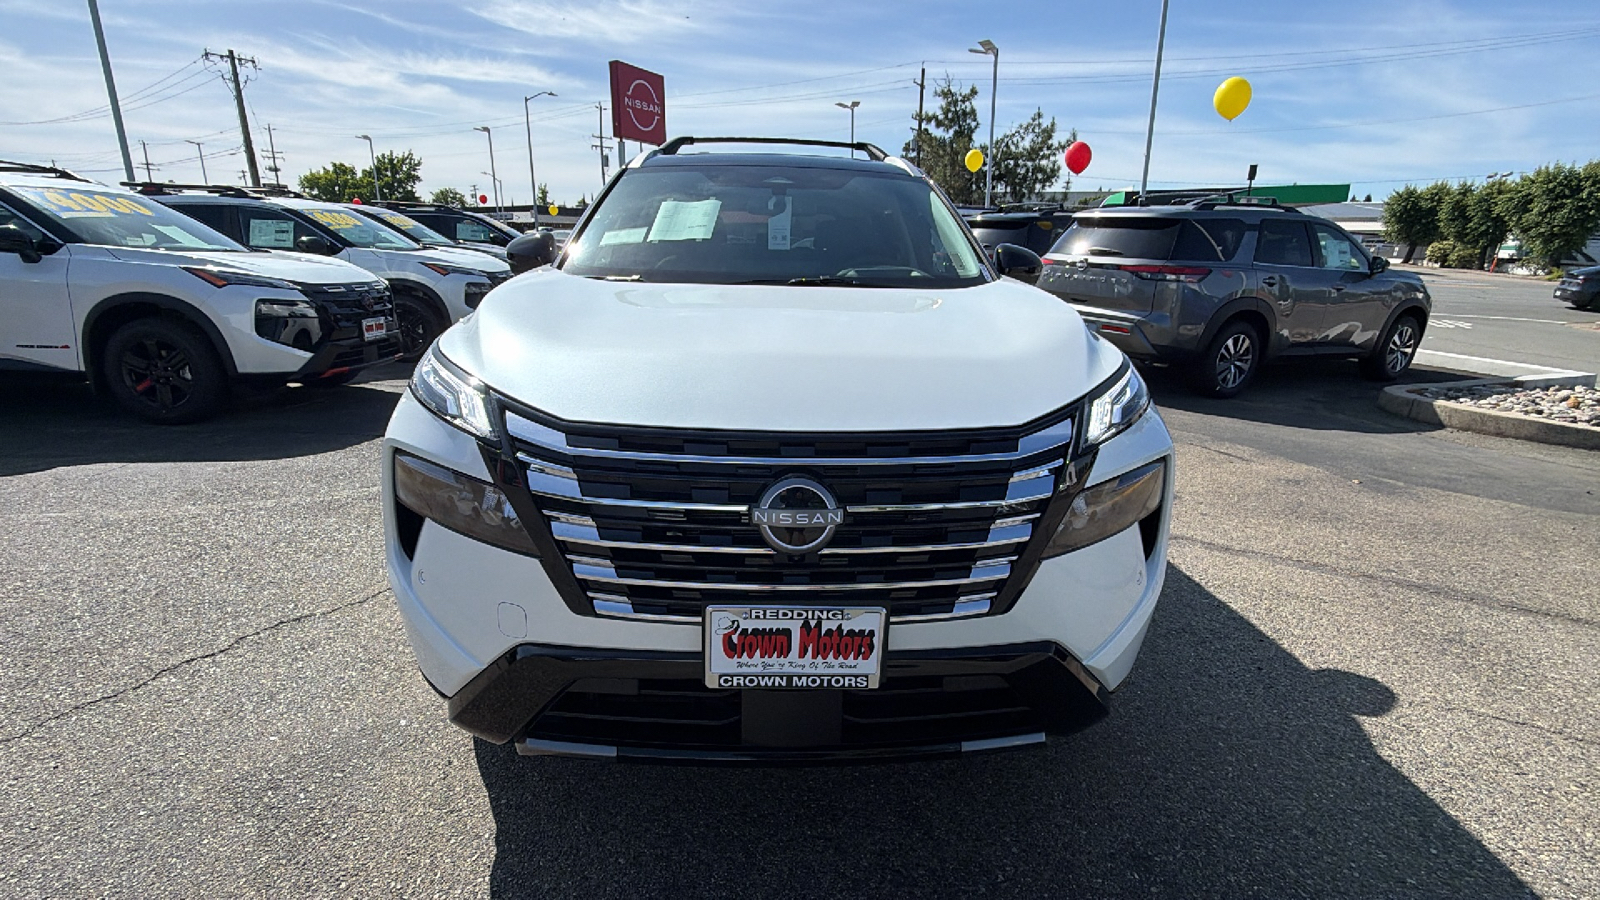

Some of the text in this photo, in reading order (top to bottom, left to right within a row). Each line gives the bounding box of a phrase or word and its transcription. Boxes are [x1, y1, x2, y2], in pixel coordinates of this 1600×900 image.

[624, 96, 661, 114] NISSAN
[754, 511, 841, 524] NISSAN
[751, 609, 843, 620] REDDING
[722, 621, 875, 661] Crown Motors
[736, 661, 758, 669] Where
[760, 661, 785, 671] You're
[788, 661, 806, 670] King
[809, 661, 819, 670] Of
[821, 661, 835, 669] The
[719, 676, 868, 688] CROWN MOTORS
